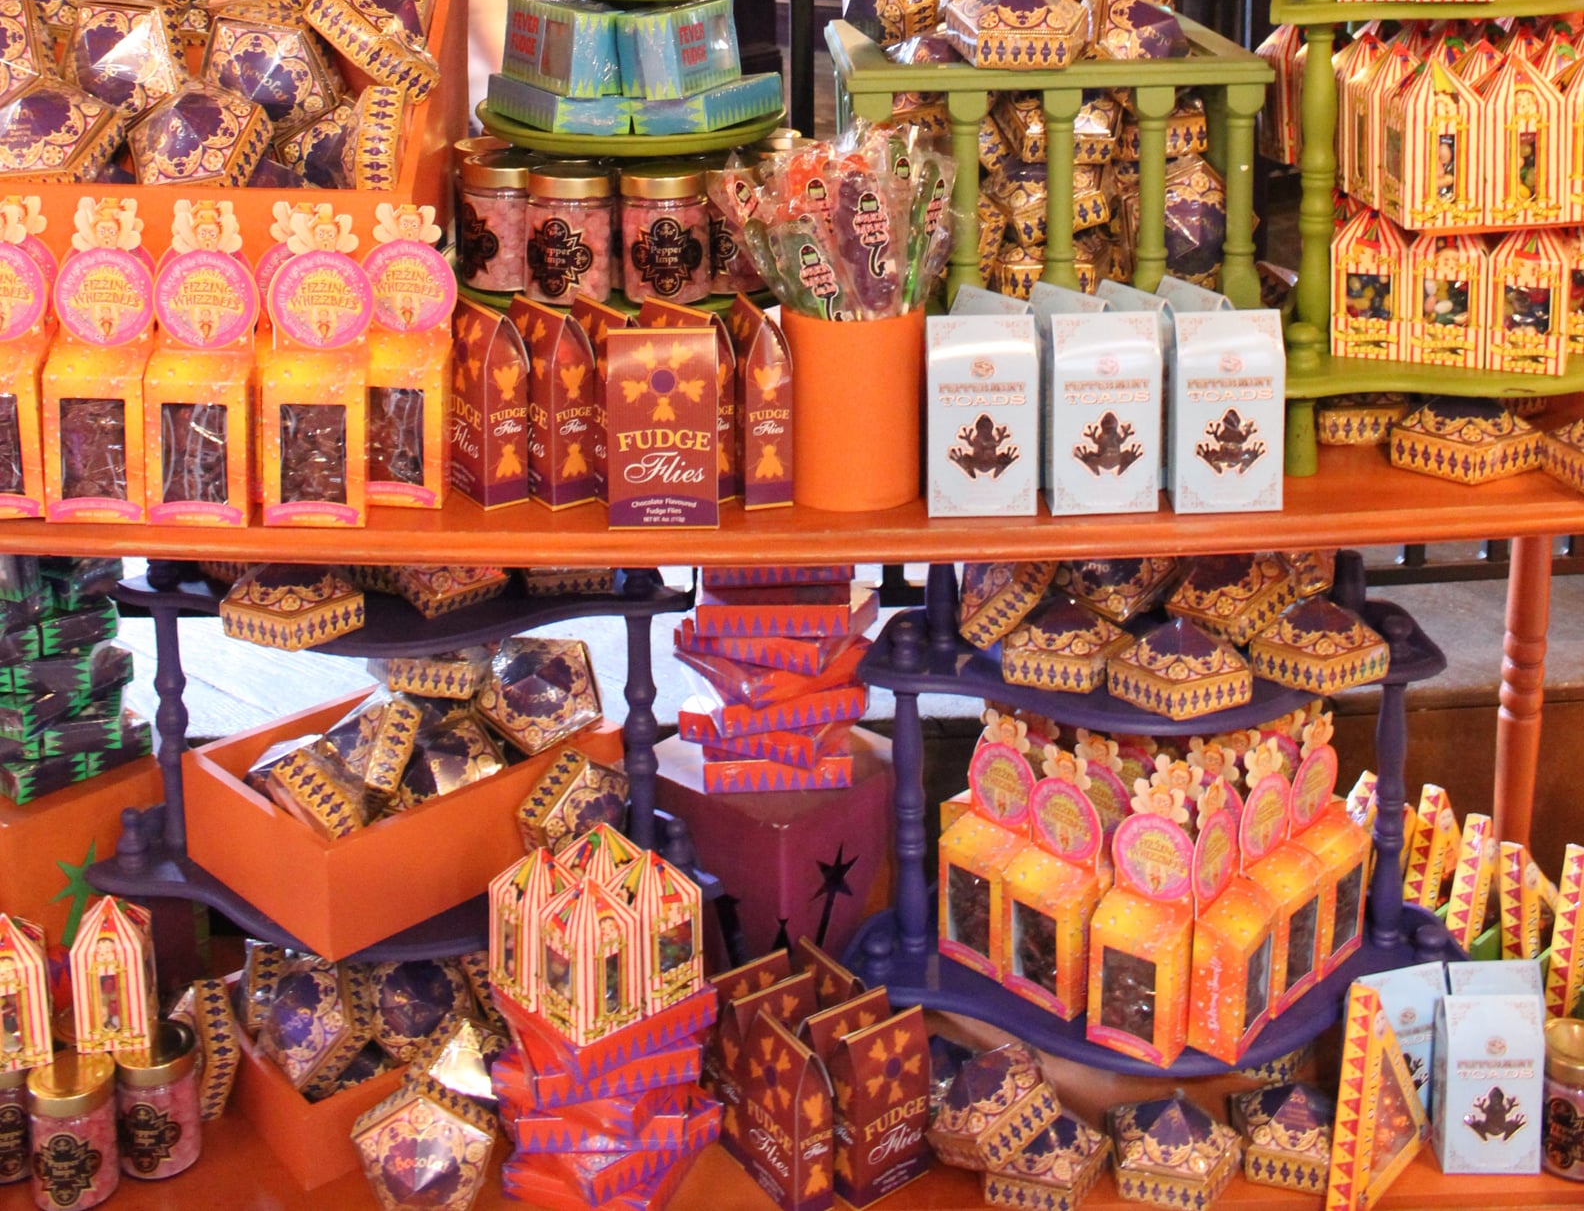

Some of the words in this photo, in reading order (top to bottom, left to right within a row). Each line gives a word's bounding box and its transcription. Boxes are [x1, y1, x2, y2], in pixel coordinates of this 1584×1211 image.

[513, 10, 540, 35] FEVER
[679, 21, 705, 46] FEVER
[511, 31, 537, 56] FUDGE
[682, 43, 708, 67] FUDGE
[650, 246, 682, 257] Pepper
[655, 255, 679, 266] Imps
[82, 278, 133, 293] FIZZING
[181, 280, 233, 295] FIZZING
[300, 280, 352, 295] FIZZING
[938, 381, 1026, 394] PEPPERMINT
[1064, 378, 1150, 392] PEPPERMINT
[1187, 376, 1273, 390] PEPPERMINT
[938, 393, 1027, 407] TOADS
[1064, 390, 1151, 406] TOADS
[1186, 388, 1274, 403] TOADS
[490, 407, 527, 424] FUDGE
[555, 406, 592, 423] FUDGE
[749, 408, 790, 423] FUDGE
[494, 419, 522, 437] Flies
[560, 418, 588, 436] Flies
[753, 419, 785, 436] Flies
[616, 428, 711, 452] FUDGE
[624, 450, 705, 484] Flies
[631, 497, 664, 509] Chocolate
[665, 497, 697, 509] Flavoured
[646, 506, 666, 516] Fudge
[667, 506, 682, 515] Flies
[1456, 1068, 1535, 1080] TOADS
[747, 1098, 792, 1156] FUDGE
[864, 1095, 927, 1143] FUDGE
[800, 1128, 833, 1150] FUDGE
[867, 1122, 923, 1165] Flies
[749, 1127, 790, 1178] Flies
